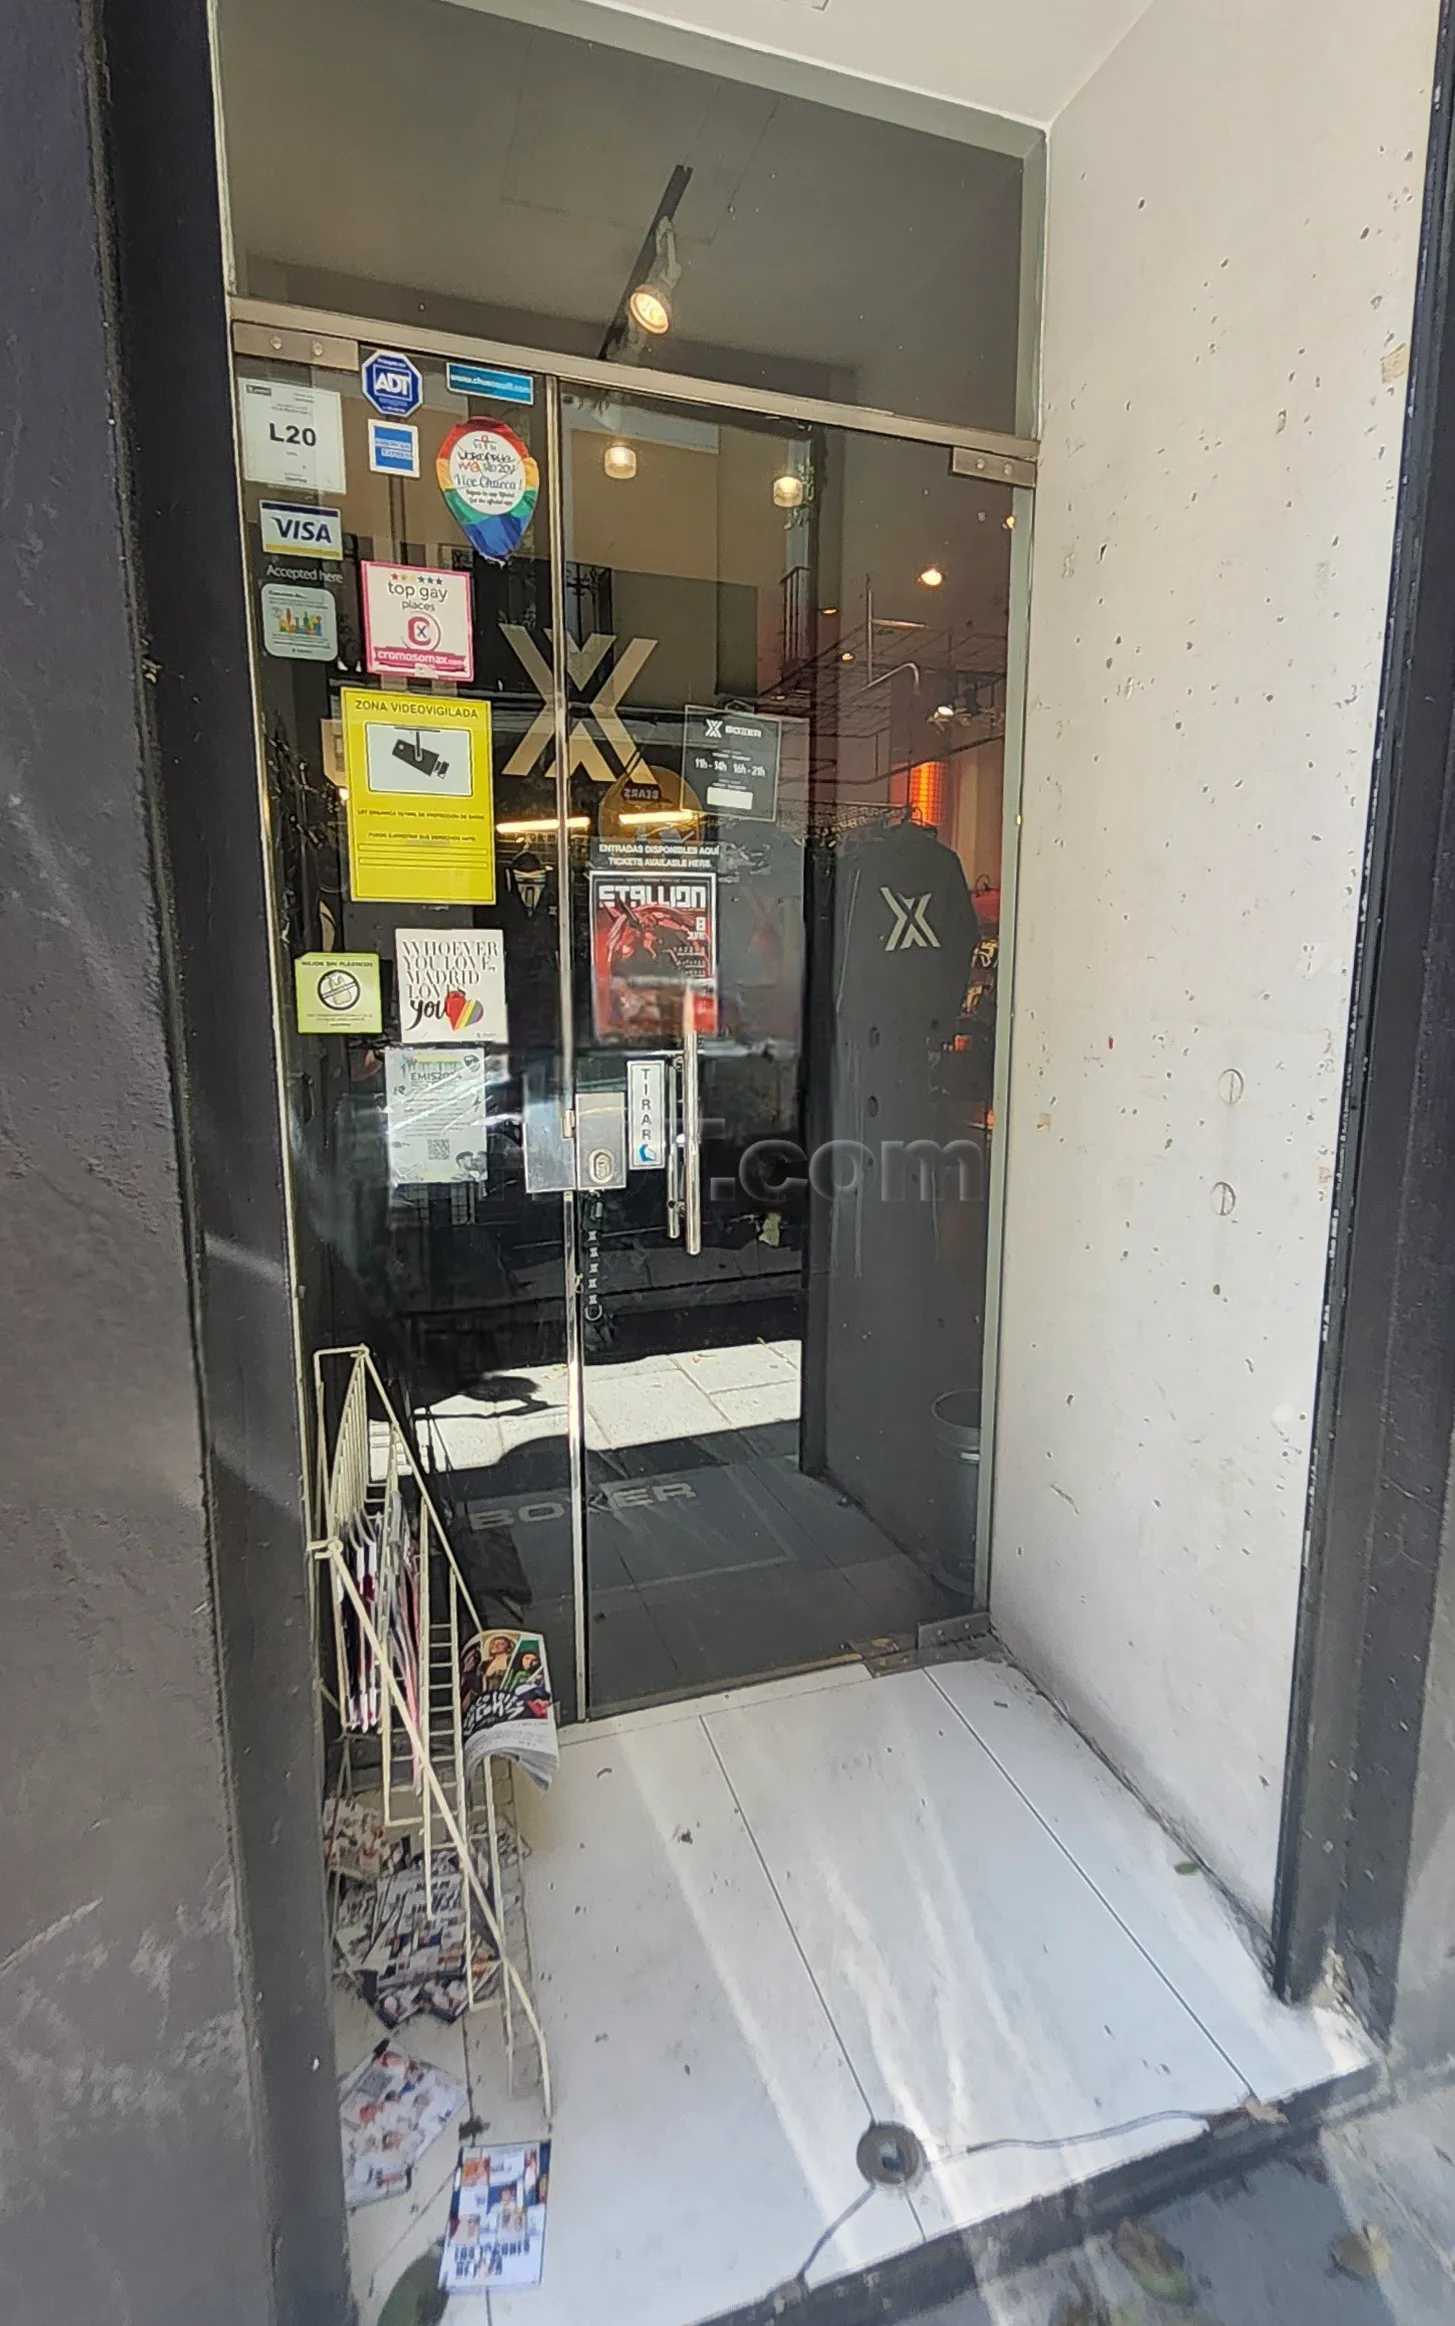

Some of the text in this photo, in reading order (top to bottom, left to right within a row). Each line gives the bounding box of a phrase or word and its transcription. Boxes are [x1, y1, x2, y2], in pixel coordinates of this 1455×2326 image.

[374, 371, 410, 396] ADT
[268, 421, 317, 447] L20
[271, 516, 332, 544] VISA
[266, 564, 344, 584] Accepted here
[388, 580, 448, 603] top gay
[402, 600, 436, 612] places
[377, 650, 464, 667] cromosomax.com
[355, 700, 478, 718] ZONA VIDEOVIGILADA
[599, 844, 719, 856] ENTRADAS DISPONIBLES AQUÍ
[608, 857, 643, 866] TICKETS
[644, 858, 687, 867] AVAILABLE
[599, 885, 706, 908] STALLION
[402, 941, 499, 956] WHOEVER
[403, 955, 496, 972] YOU LOVE,
[407, 970, 480, 985] MADRID
[405, 999, 448, 1031] you
[641, 1067, 652, 1141] TIRAR
